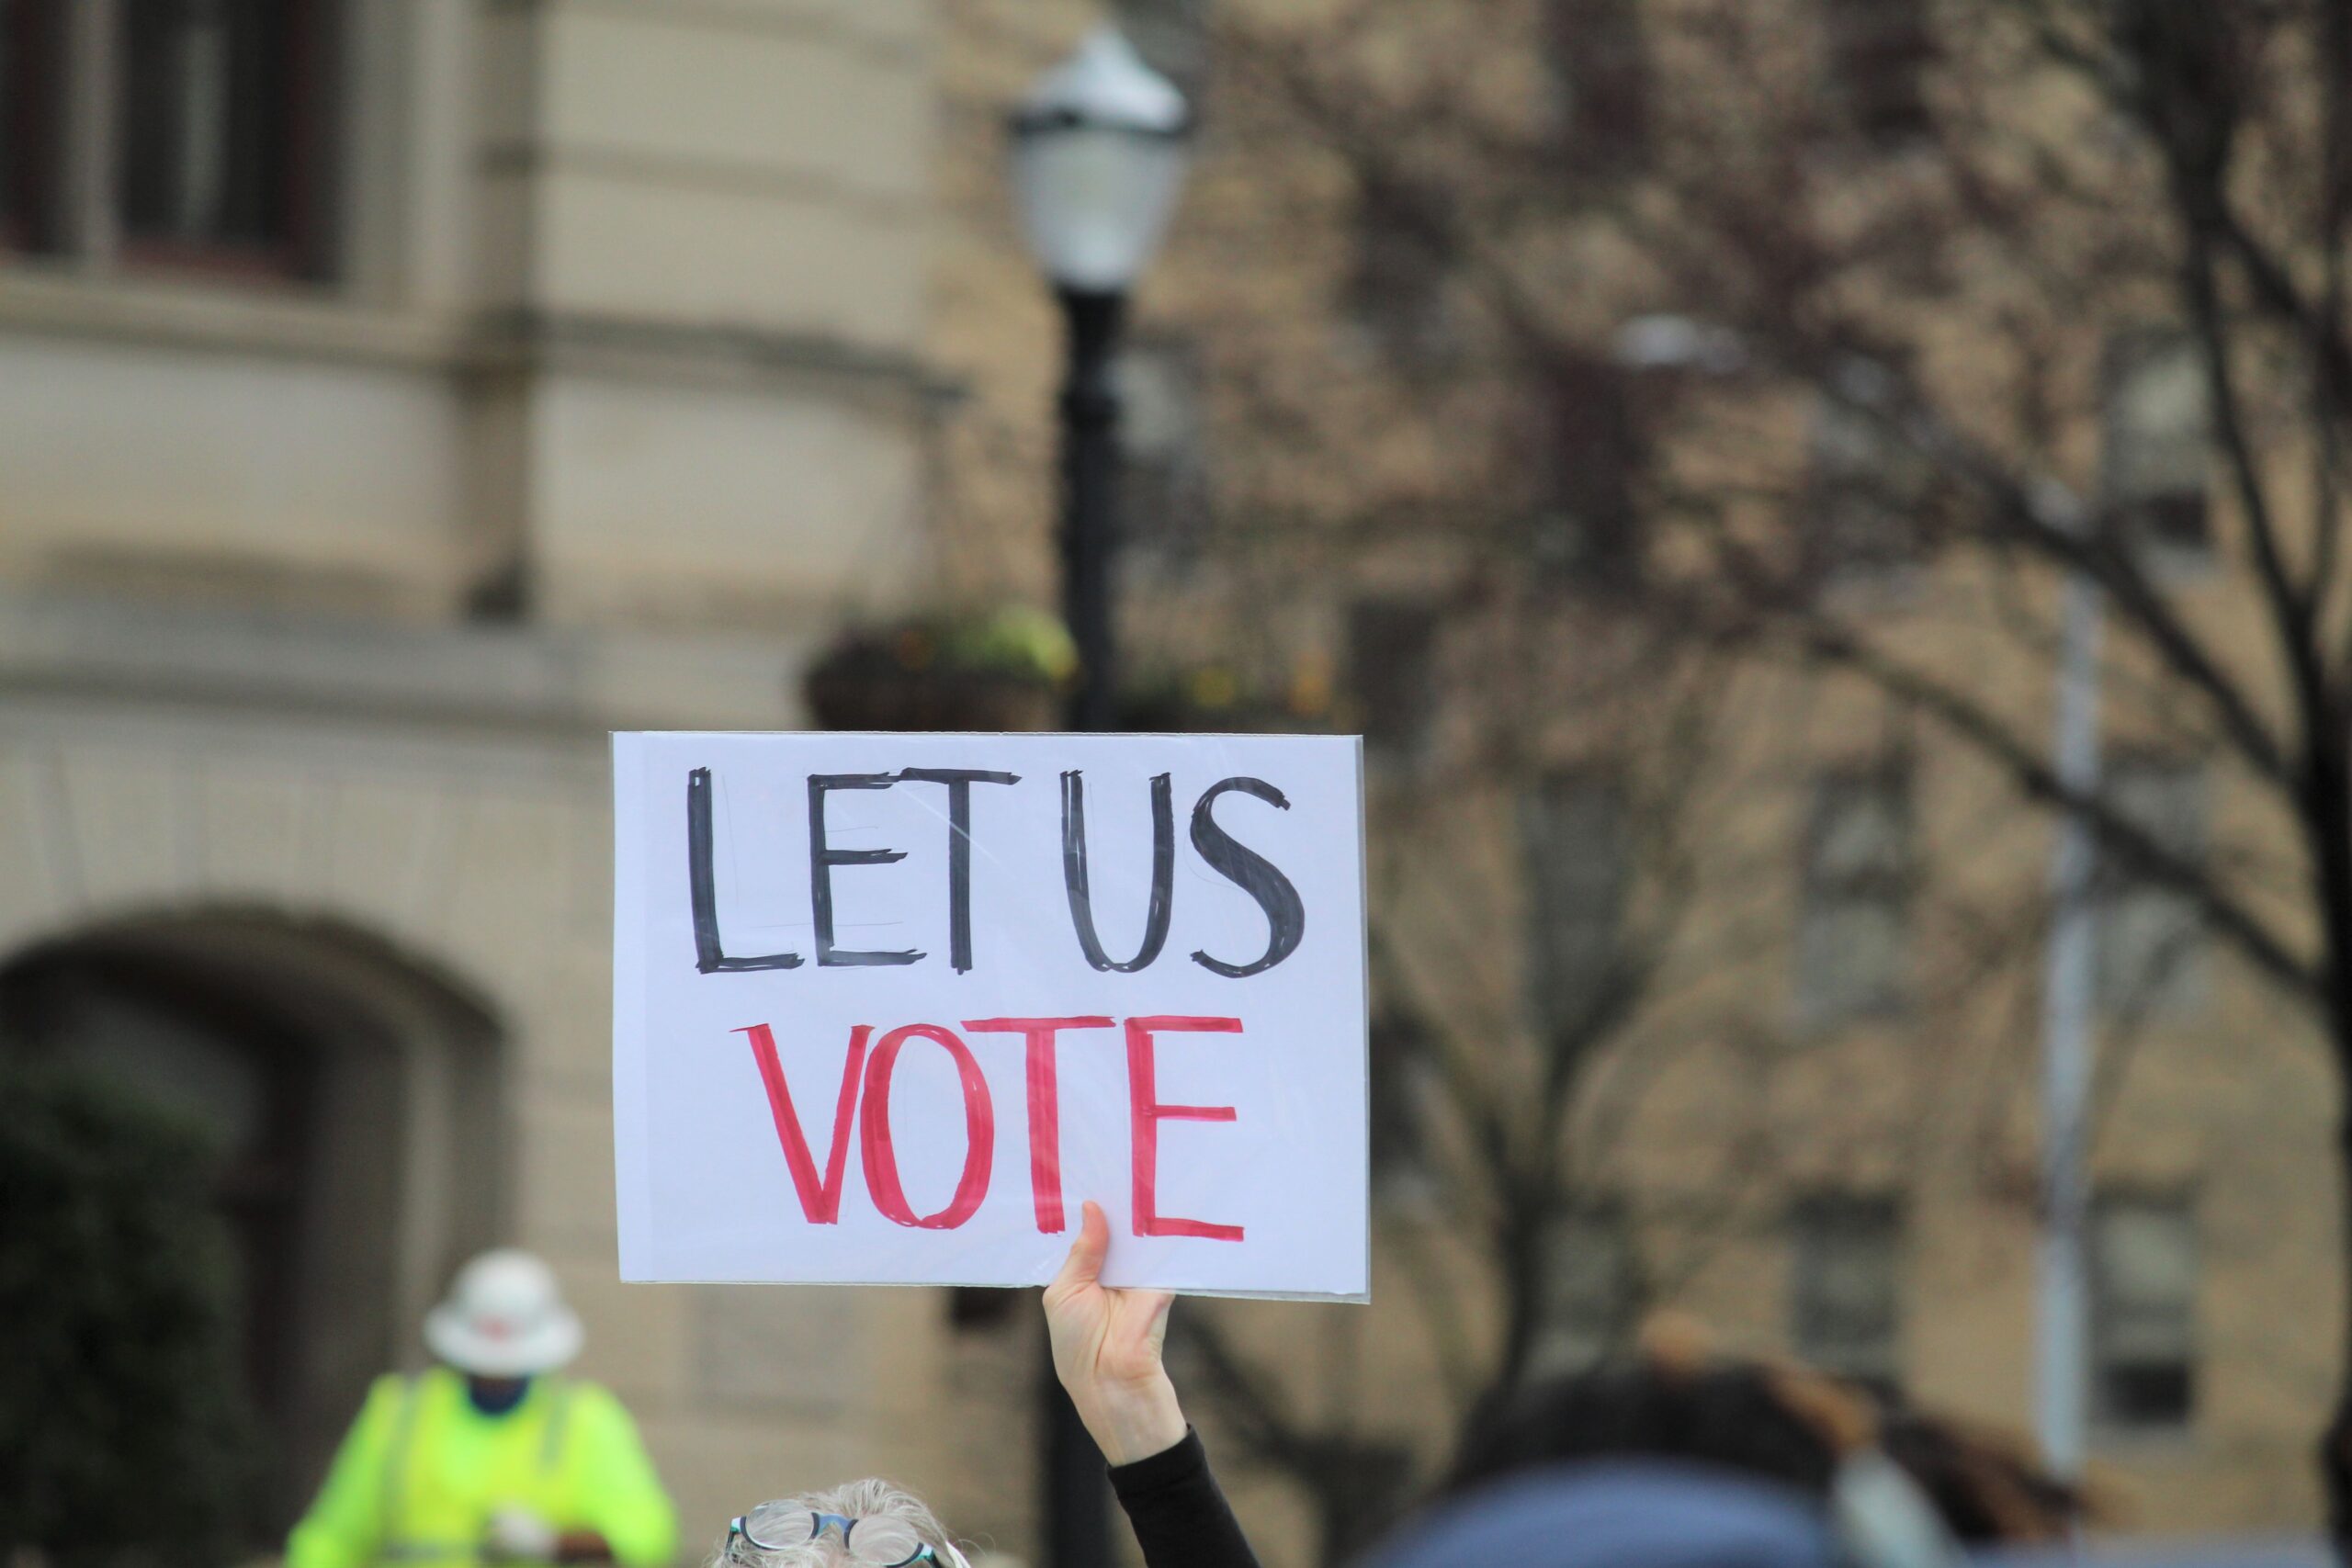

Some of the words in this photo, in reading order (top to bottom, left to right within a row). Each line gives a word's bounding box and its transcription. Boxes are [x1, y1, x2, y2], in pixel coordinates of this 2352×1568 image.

[687, 767, 1022, 975] LET
[1060, 770, 1306, 978] US
[730, 1016, 1244, 1241] VOTE
